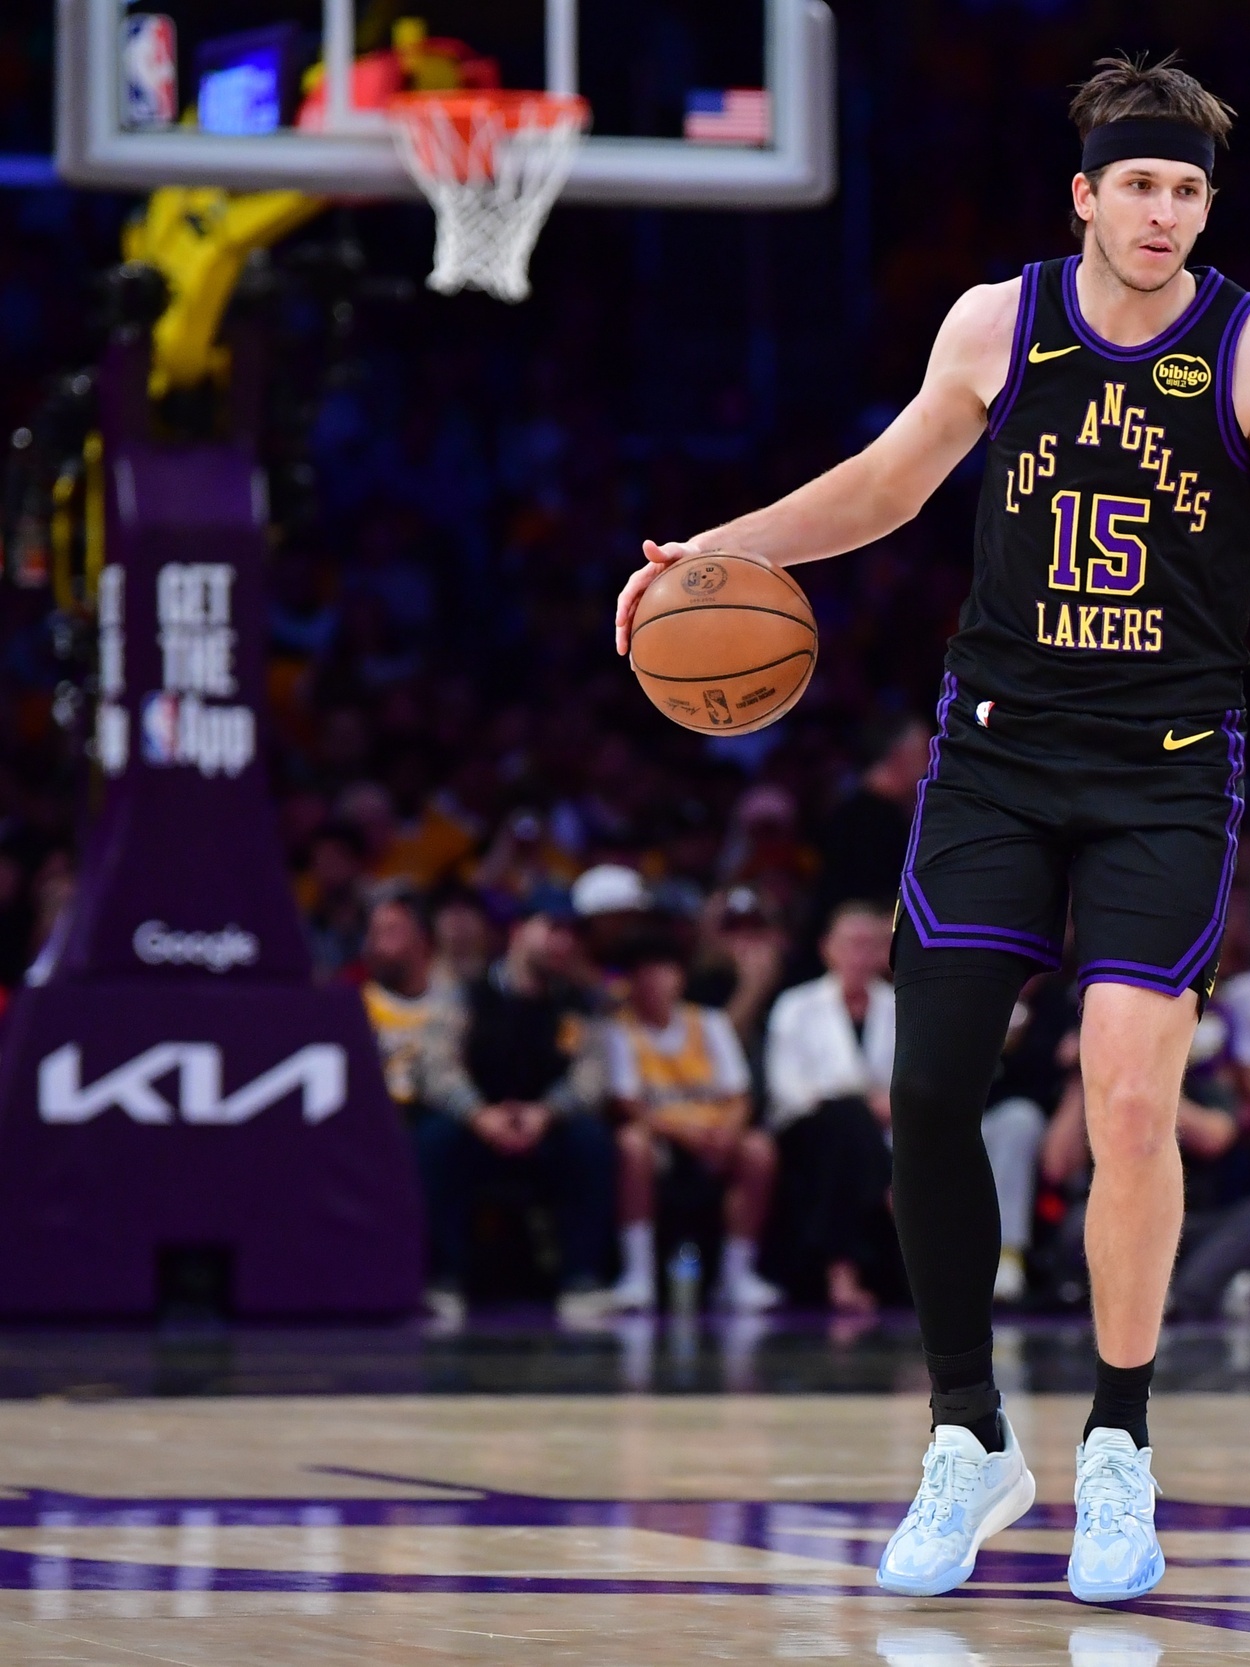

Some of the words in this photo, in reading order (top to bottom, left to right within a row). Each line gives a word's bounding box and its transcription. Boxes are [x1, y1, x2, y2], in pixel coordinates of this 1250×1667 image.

[1158, 363, 1208, 386] bibigo
[1006, 432, 1058, 513] LOS
[1076, 380, 1212, 533] ANGELES
[1048, 489, 1150, 596] 15
[1035, 601, 1164, 651] LAKERS
[38, 1041, 348, 1124] KIA
